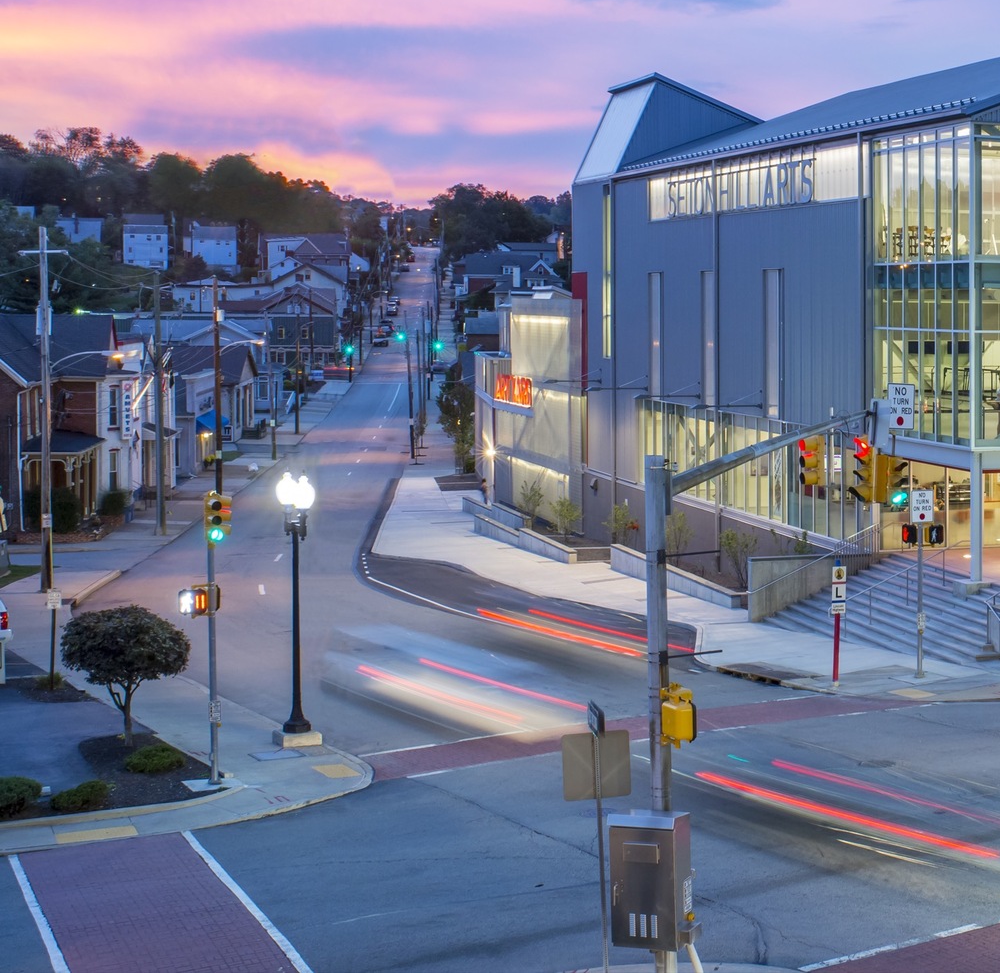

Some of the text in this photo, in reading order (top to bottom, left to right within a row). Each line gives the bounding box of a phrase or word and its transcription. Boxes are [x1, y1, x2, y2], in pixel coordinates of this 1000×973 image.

[668, 159, 813, 218] SETON HILL ARTS
[895, 387, 907, 396] NO
[893, 397, 909, 405] TURN
[901, 407, 912, 415] RED
[835, 587, 842, 598] L
